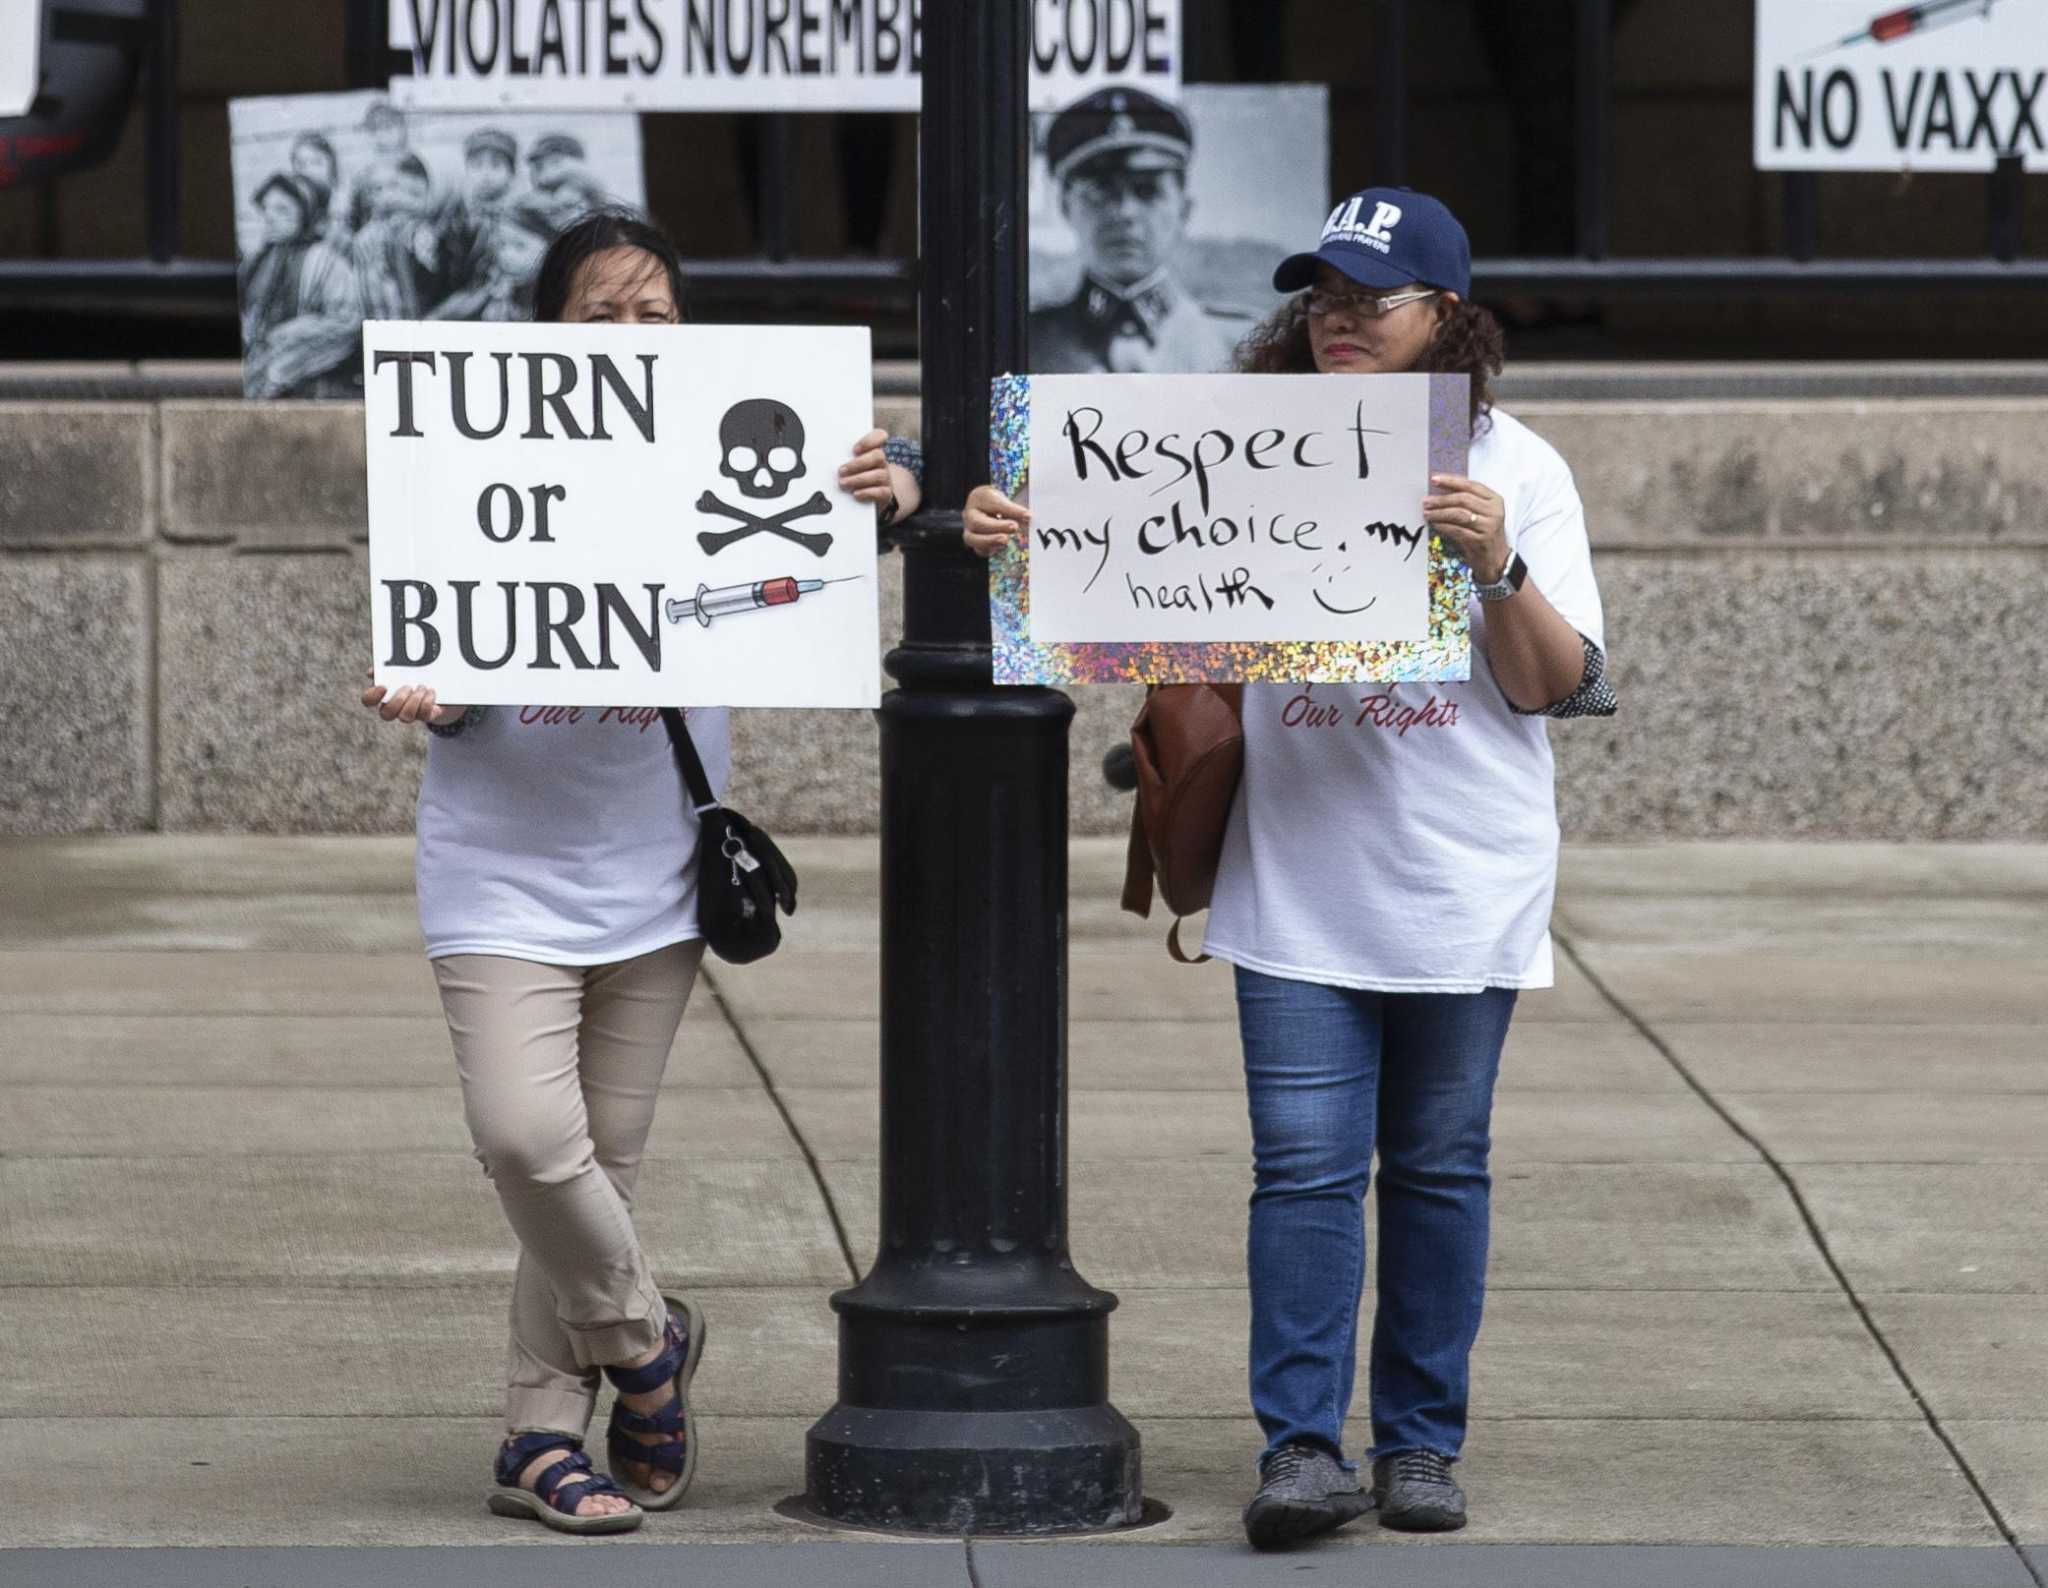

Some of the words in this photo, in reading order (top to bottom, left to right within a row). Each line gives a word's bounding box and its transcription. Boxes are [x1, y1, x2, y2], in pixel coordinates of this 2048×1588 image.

[406, 0, 664, 77] VIOLATES
[685, 0, 923, 76] NUREMBE
[1031, 0, 1170, 74] CODE
[1774, 66, 1857, 150] NO
[1880, 67, 2046, 150] VAXX
[373, 349, 659, 443] TURN
[1062, 399, 1393, 517] Respect
[477, 482, 567, 543] or
[1036, 515, 1114, 595] my
[1364, 520, 1425, 563] my
[1125, 566, 1275, 614] health
[381, 578, 666, 673] BURN
[1281, 695, 1344, 728] Our
[1354, 695, 1461, 737] Rights
